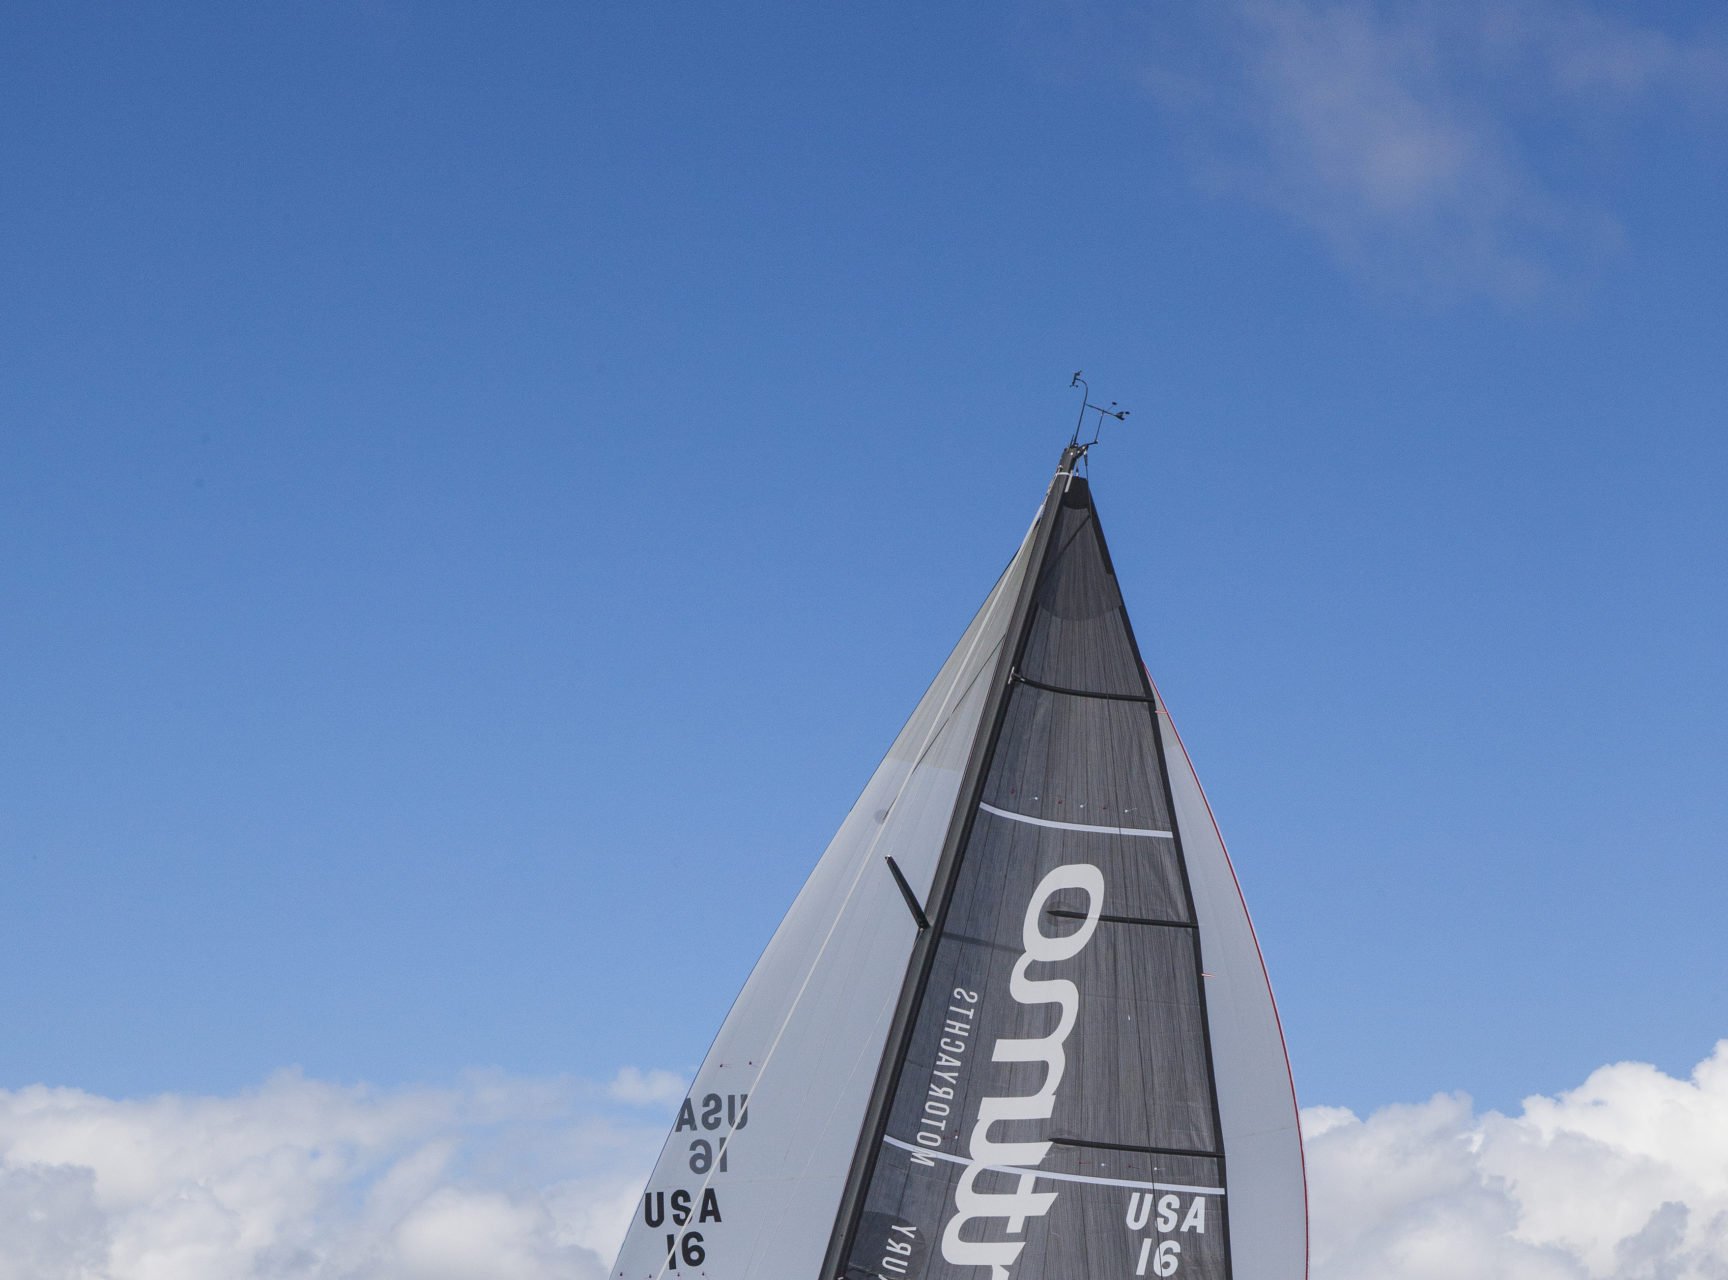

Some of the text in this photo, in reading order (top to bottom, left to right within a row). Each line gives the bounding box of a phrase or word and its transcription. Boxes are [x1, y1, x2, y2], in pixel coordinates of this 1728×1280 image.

[644, 1188, 722, 1228] USA
[1126, 1192, 1206, 1234] USA
[667, 1231, 706, 1270] 16
[1136, 1238, 1181, 1277] 16
